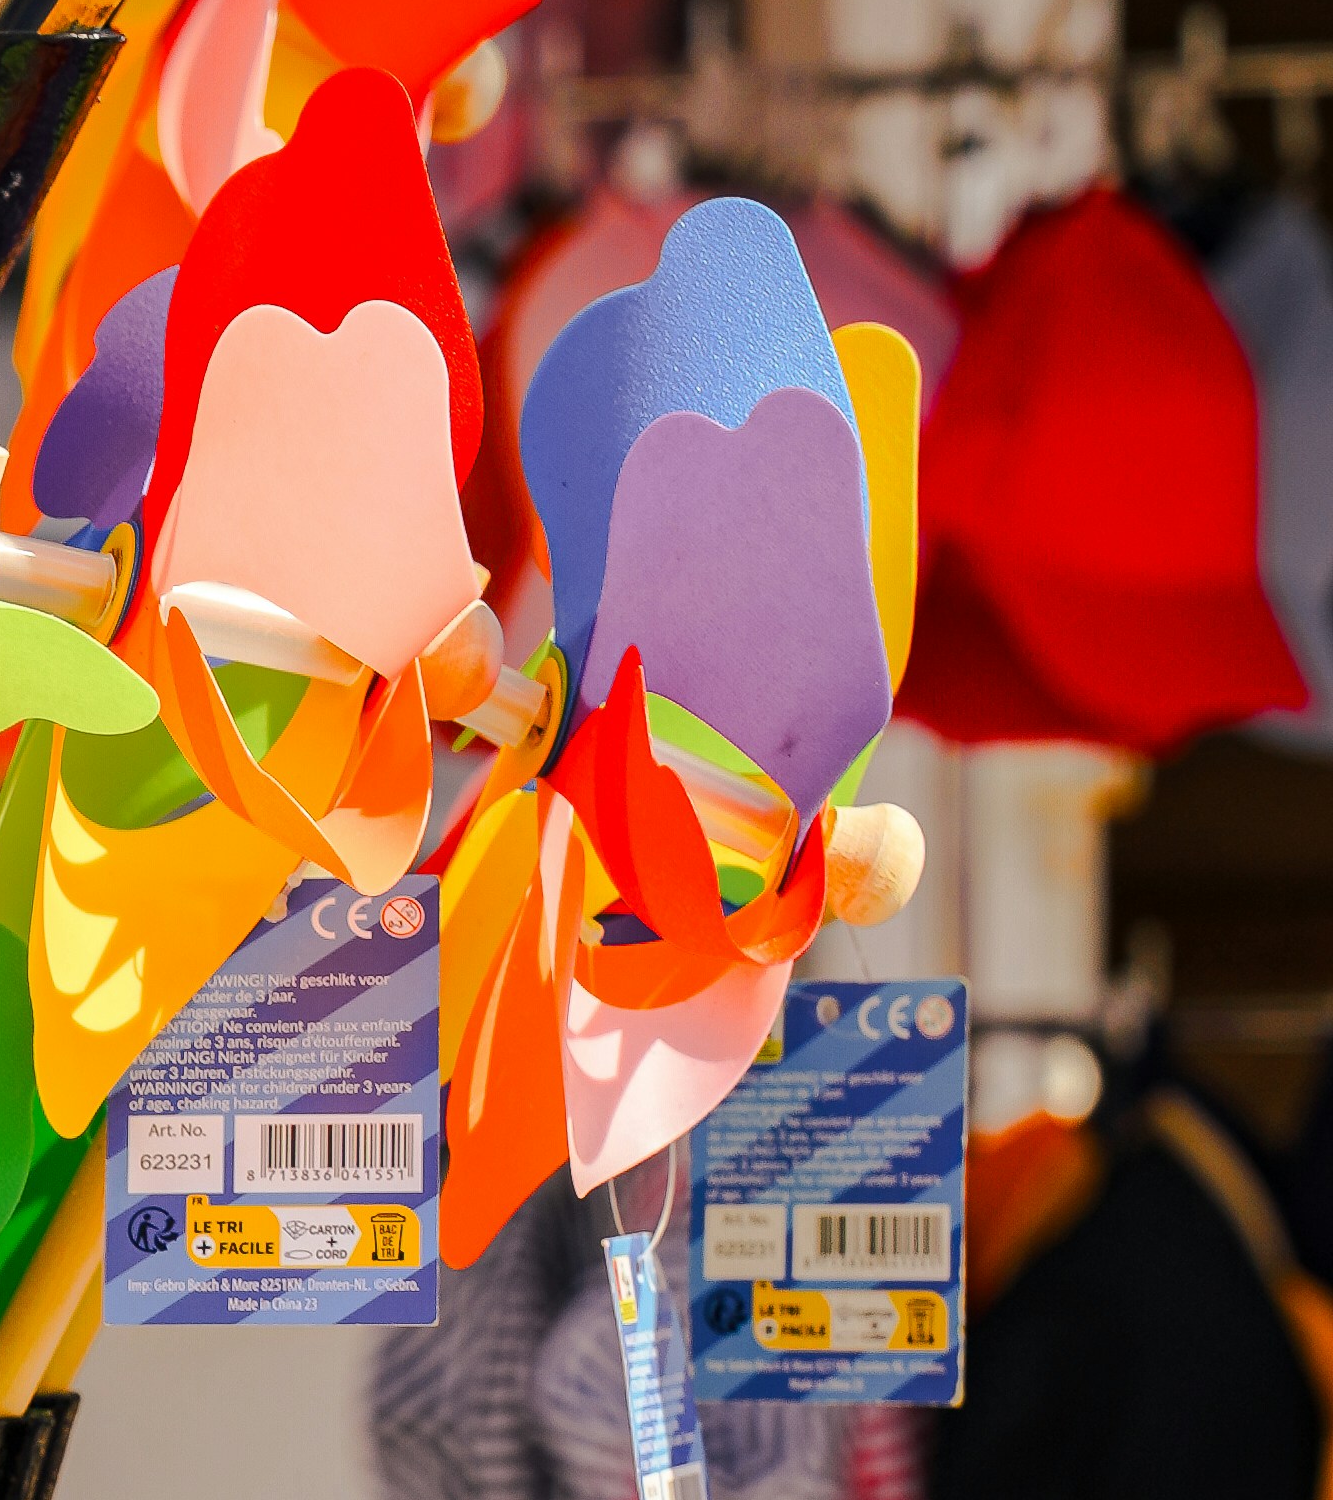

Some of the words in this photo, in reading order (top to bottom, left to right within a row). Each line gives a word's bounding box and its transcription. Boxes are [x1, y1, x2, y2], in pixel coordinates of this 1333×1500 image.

[148, 1124, 176, 1137] Art.
[181, 1124, 206, 1137] No.
[140, 1154, 211, 1170] 623231
[268, 1169, 332, 1181] 713836
[342, 1170, 404, 1181] 041551
[193, 1222, 211, 1233] LE
[217, 1222, 242, 1233] TRI
[309, 1225, 355, 1235] CARTON
[379, 1225, 397, 1234] BAC
[383, 1237, 394, 1246] DE
[220, 1242, 274, 1254] FACILE
[381, 1248, 395, 1257] TRI
[316, 1250, 347, 1259] CORD
